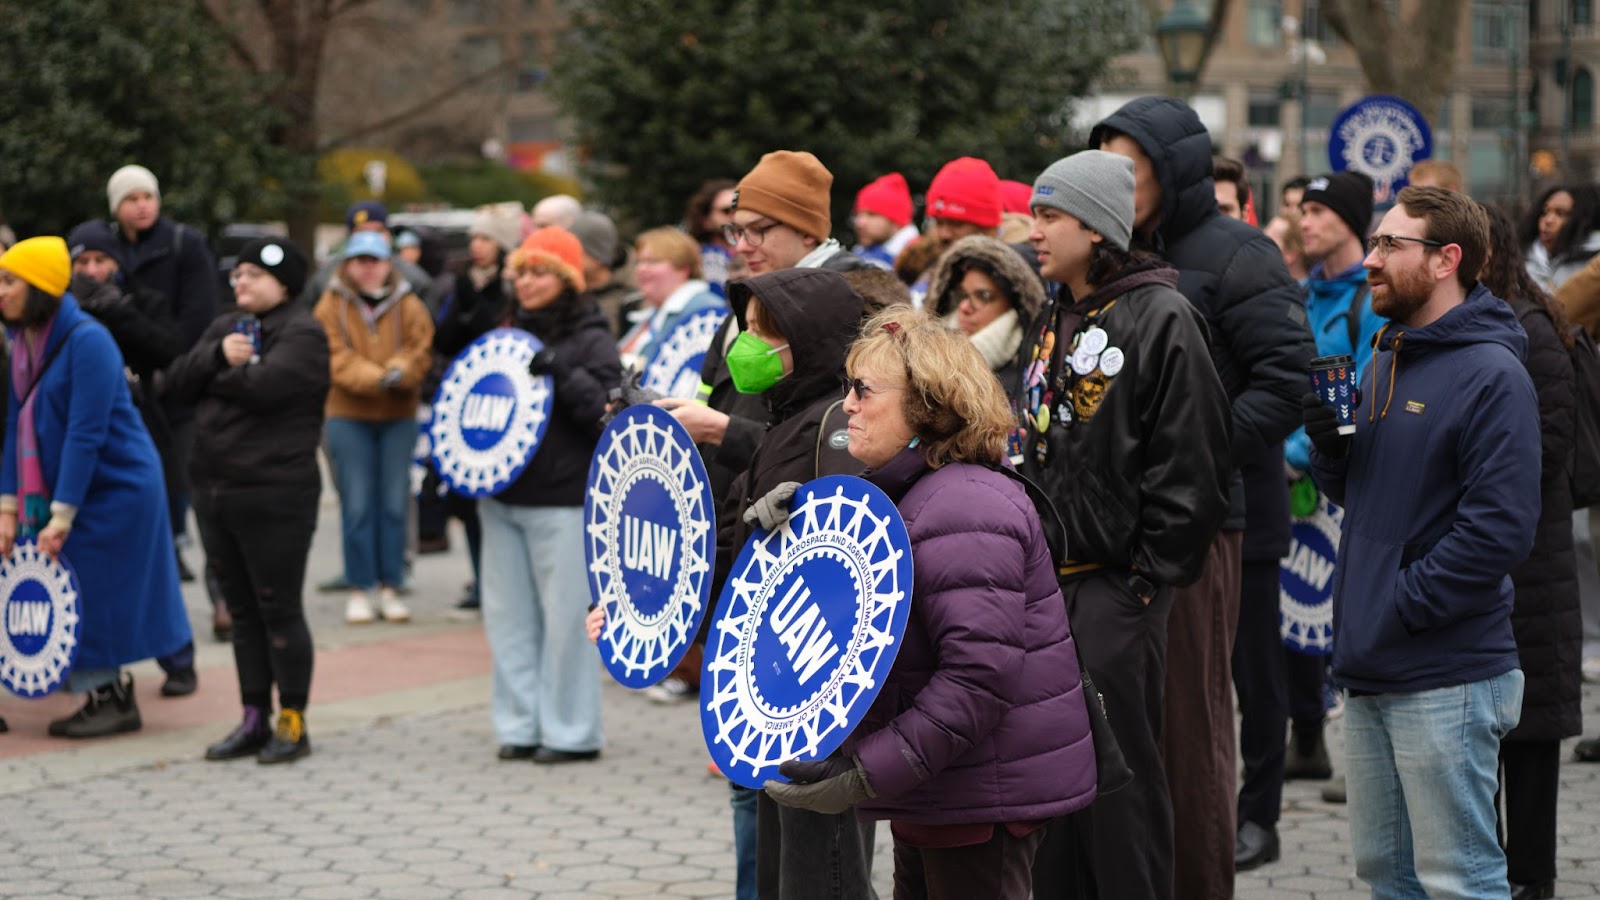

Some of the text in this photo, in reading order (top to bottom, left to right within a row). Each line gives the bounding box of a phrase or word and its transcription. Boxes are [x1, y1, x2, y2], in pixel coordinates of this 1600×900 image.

[462, 392, 515, 432] UAW
[627, 460, 639, 472] AND
[638, 457, 675, 482] AGRICULTURAL
[624, 514, 677, 581] UAW
[786, 533, 829, 560] AEROSPACE
[829, 534, 847, 547] AND
[845, 542, 874, 605] AGRICULTURAL
[9, 601, 51, 636] UAW
[769, 574, 840, 687] UAW
[846, 606, 874, 670] IMPLEMENT
[738, 627, 750, 667] UNITED
[809, 672, 847, 715] WORKERS
[764, 718, 795, 731] AMERICA
[796, 714, 808, 724] OF
